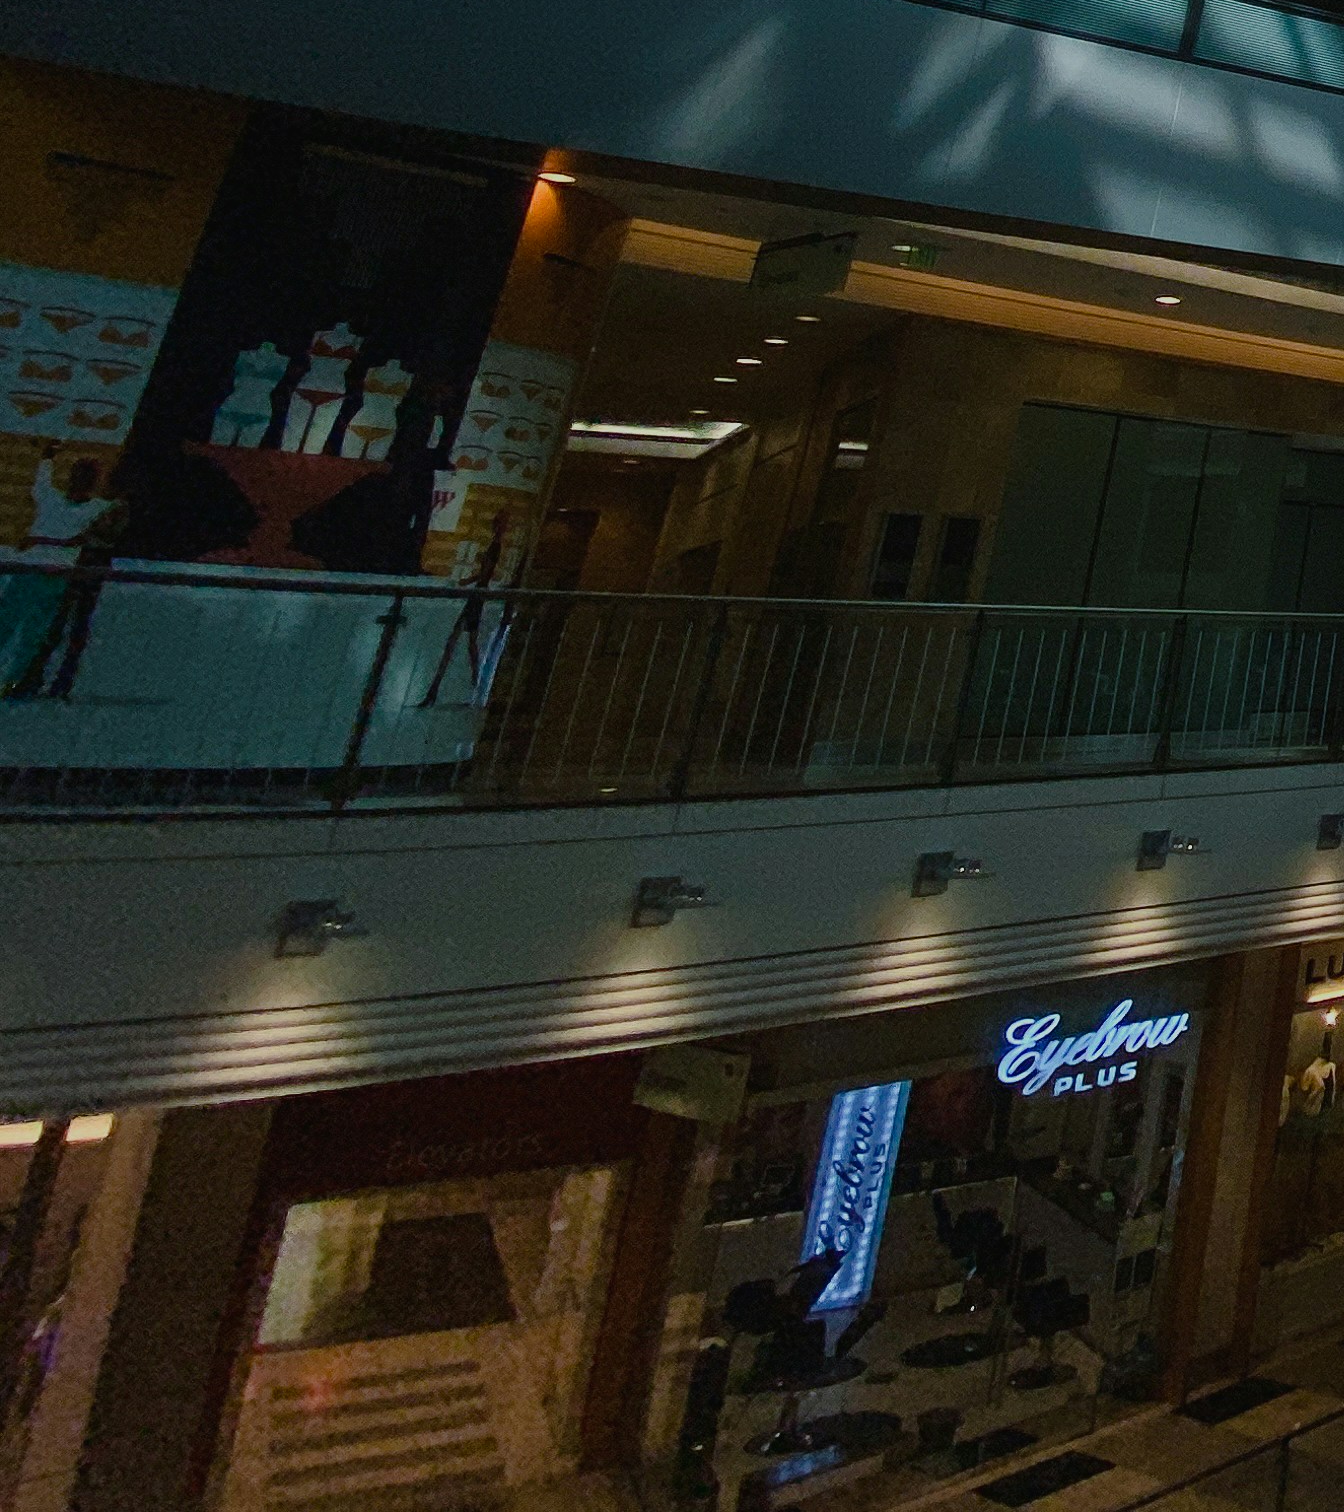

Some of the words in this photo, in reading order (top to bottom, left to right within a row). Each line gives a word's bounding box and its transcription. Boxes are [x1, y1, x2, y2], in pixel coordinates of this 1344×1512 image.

[997, 997, 1191, 1097] Eyebrow
[1052, 1060, 1139, 1098] PLUS
[862, 1142, 887, 1209] PLUS
